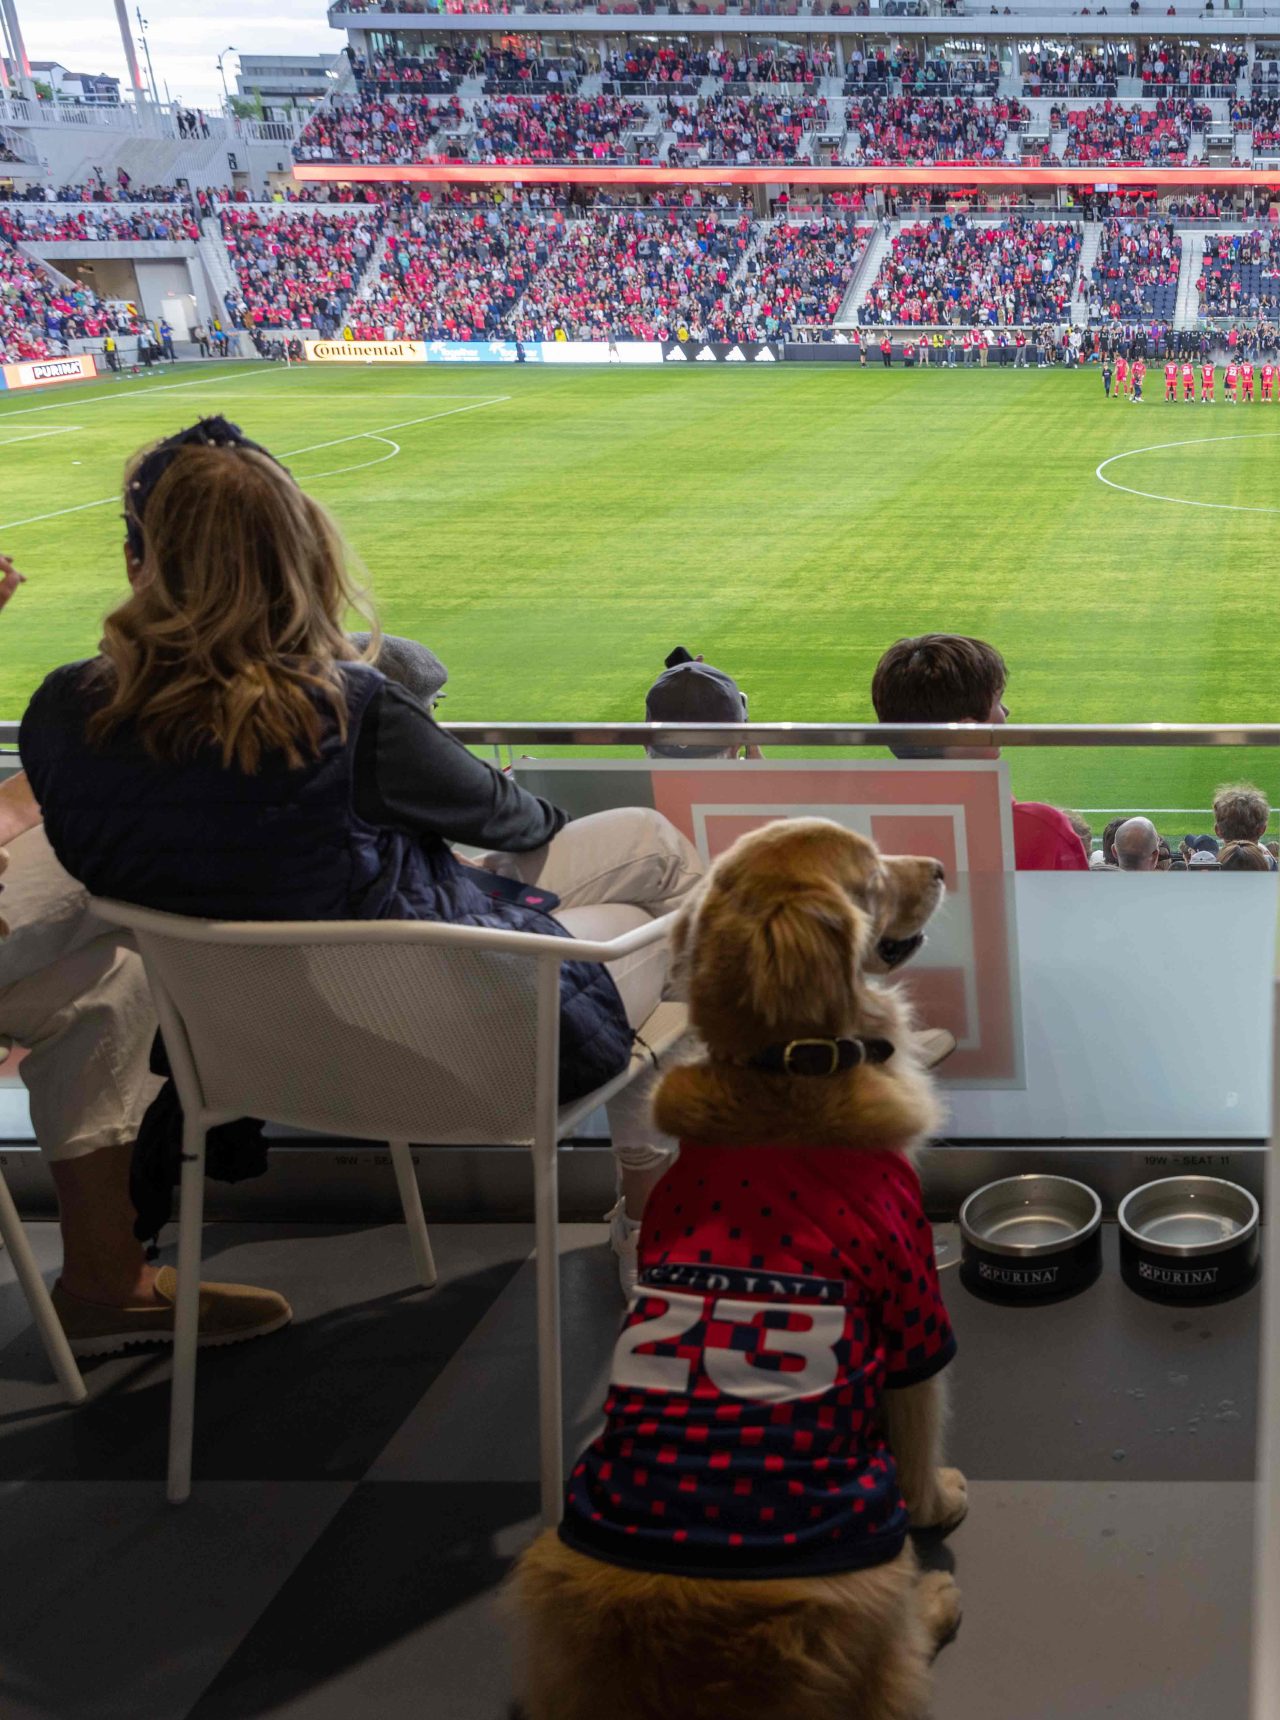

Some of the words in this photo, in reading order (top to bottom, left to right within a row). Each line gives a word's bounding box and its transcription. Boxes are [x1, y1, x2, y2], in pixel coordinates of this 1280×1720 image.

[314, 344, 403, 359] Continental
[34, 361, 80, 379] PURINA
[1145, 1155, 1167, 1165] 19W
[1183, 1155, 1214, 1165] SEAT
[1221, 1155, 1230, 1165] 11
[993, 1269, 1053, 1283] PURINA
[1153, 1268, 1212, 1283] PURINA
[610, 1284, 847, 1404] 23
